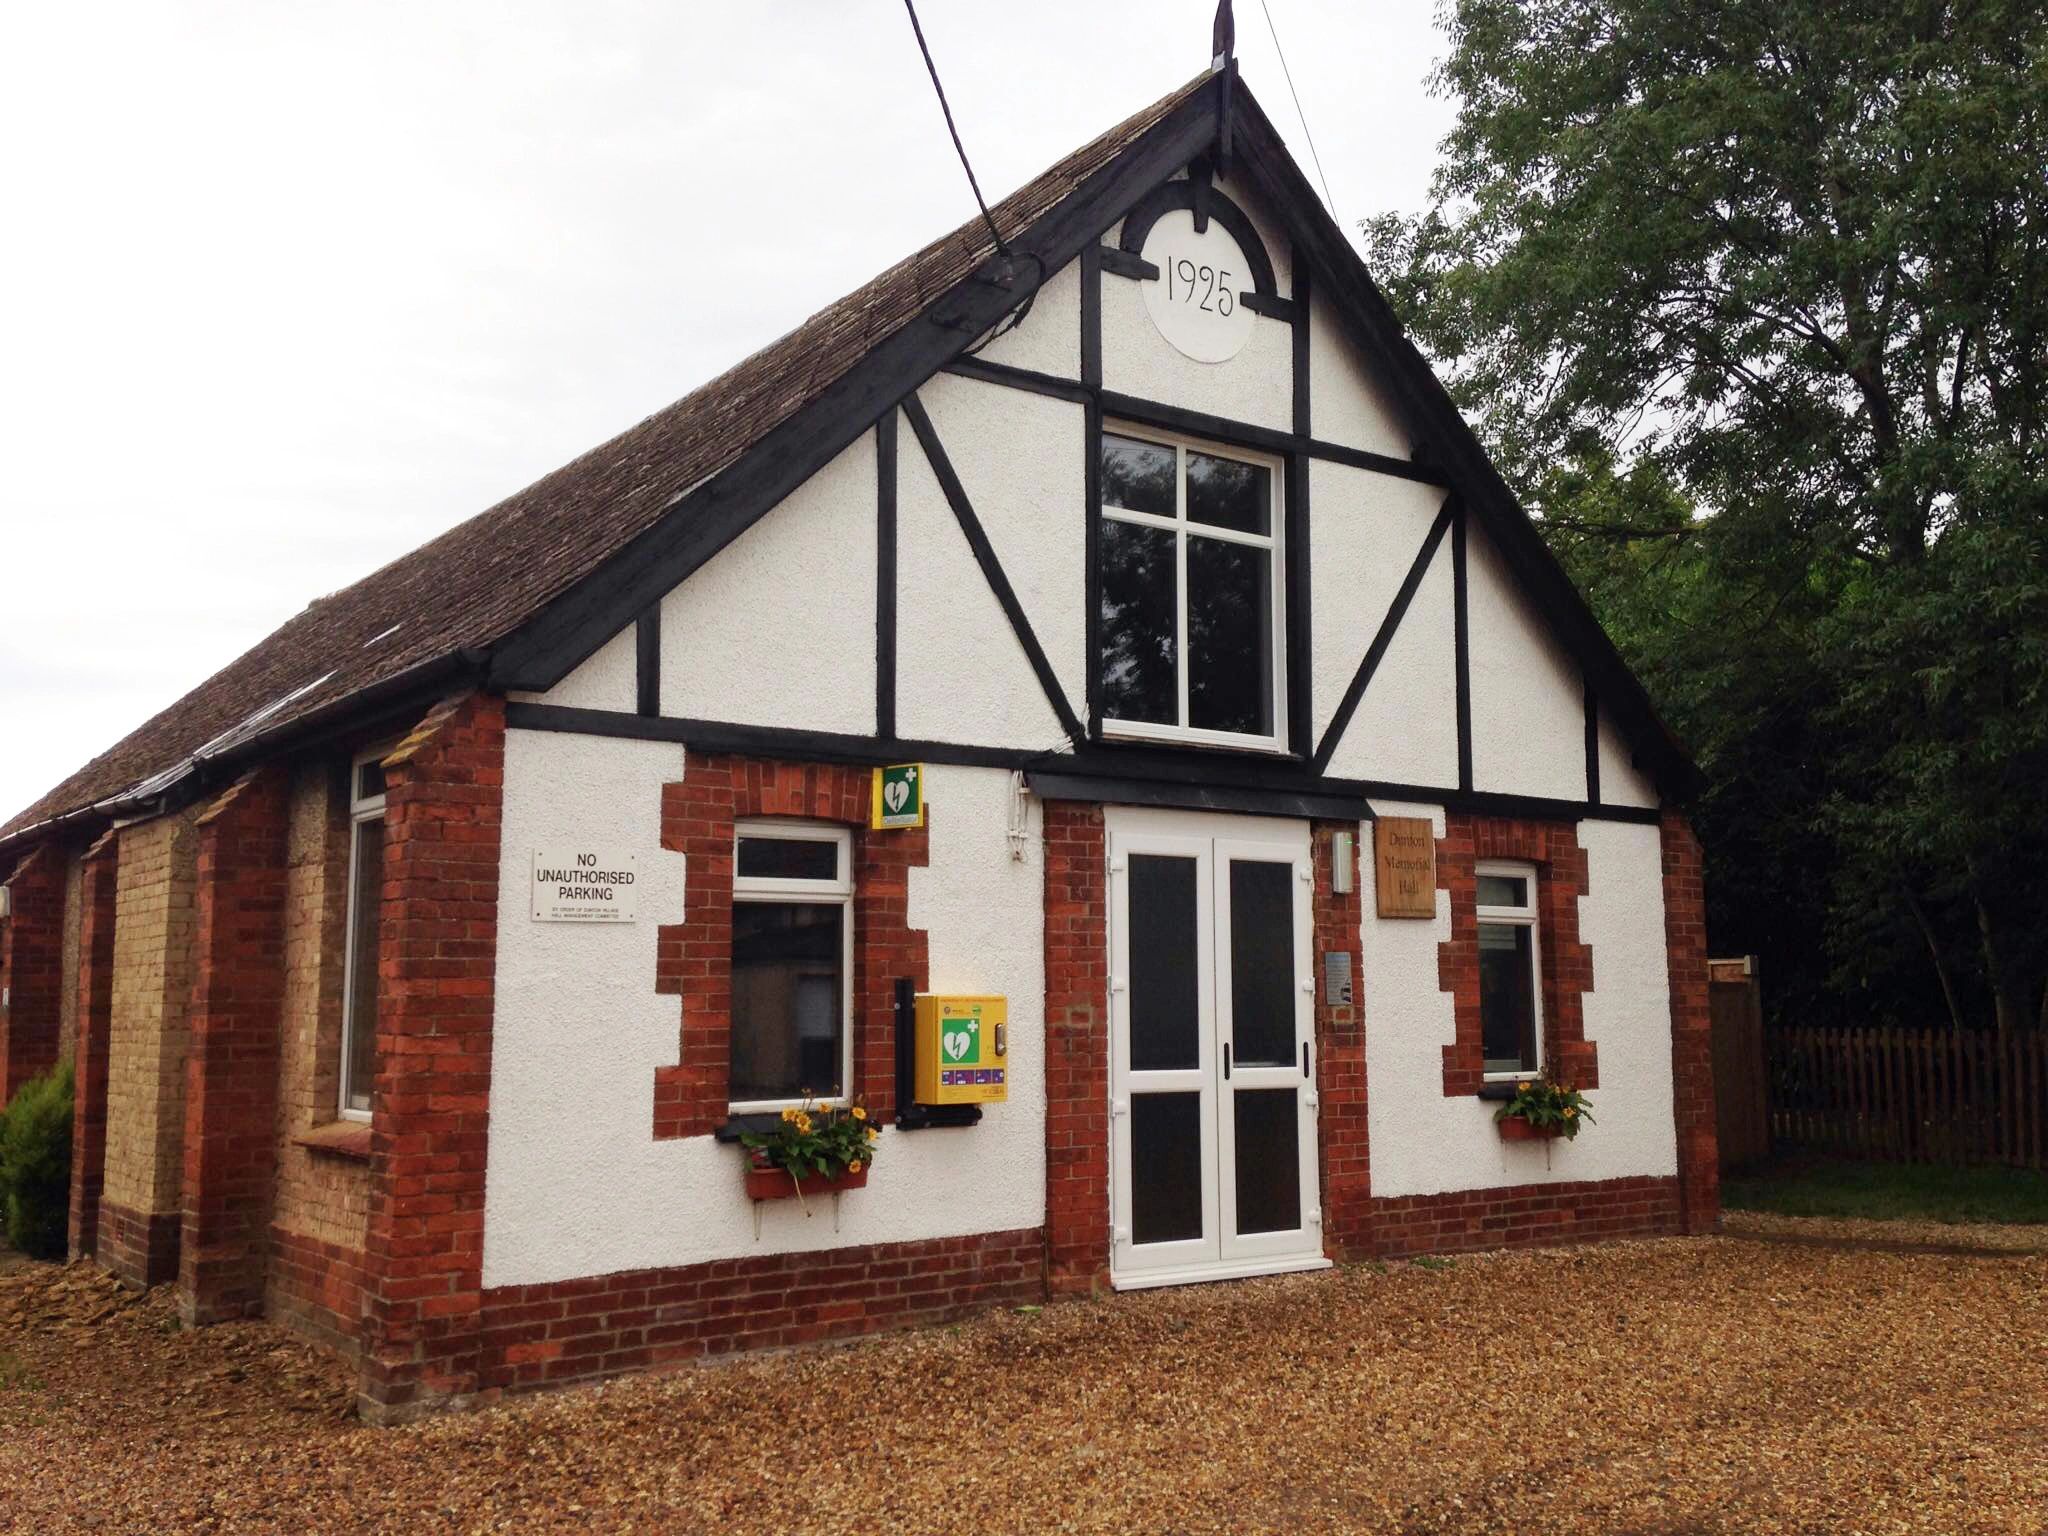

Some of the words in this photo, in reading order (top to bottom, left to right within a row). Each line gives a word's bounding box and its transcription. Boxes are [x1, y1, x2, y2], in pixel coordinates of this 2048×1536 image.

[1168, 255, 1234, 317] 1925
[577, 853, 597, 867] NO
[1384, 855, 1431, 873] Memorial
[536, 869, 635, 885] UNAUTHORISED
[558, 886, 613, 901] PARKING
